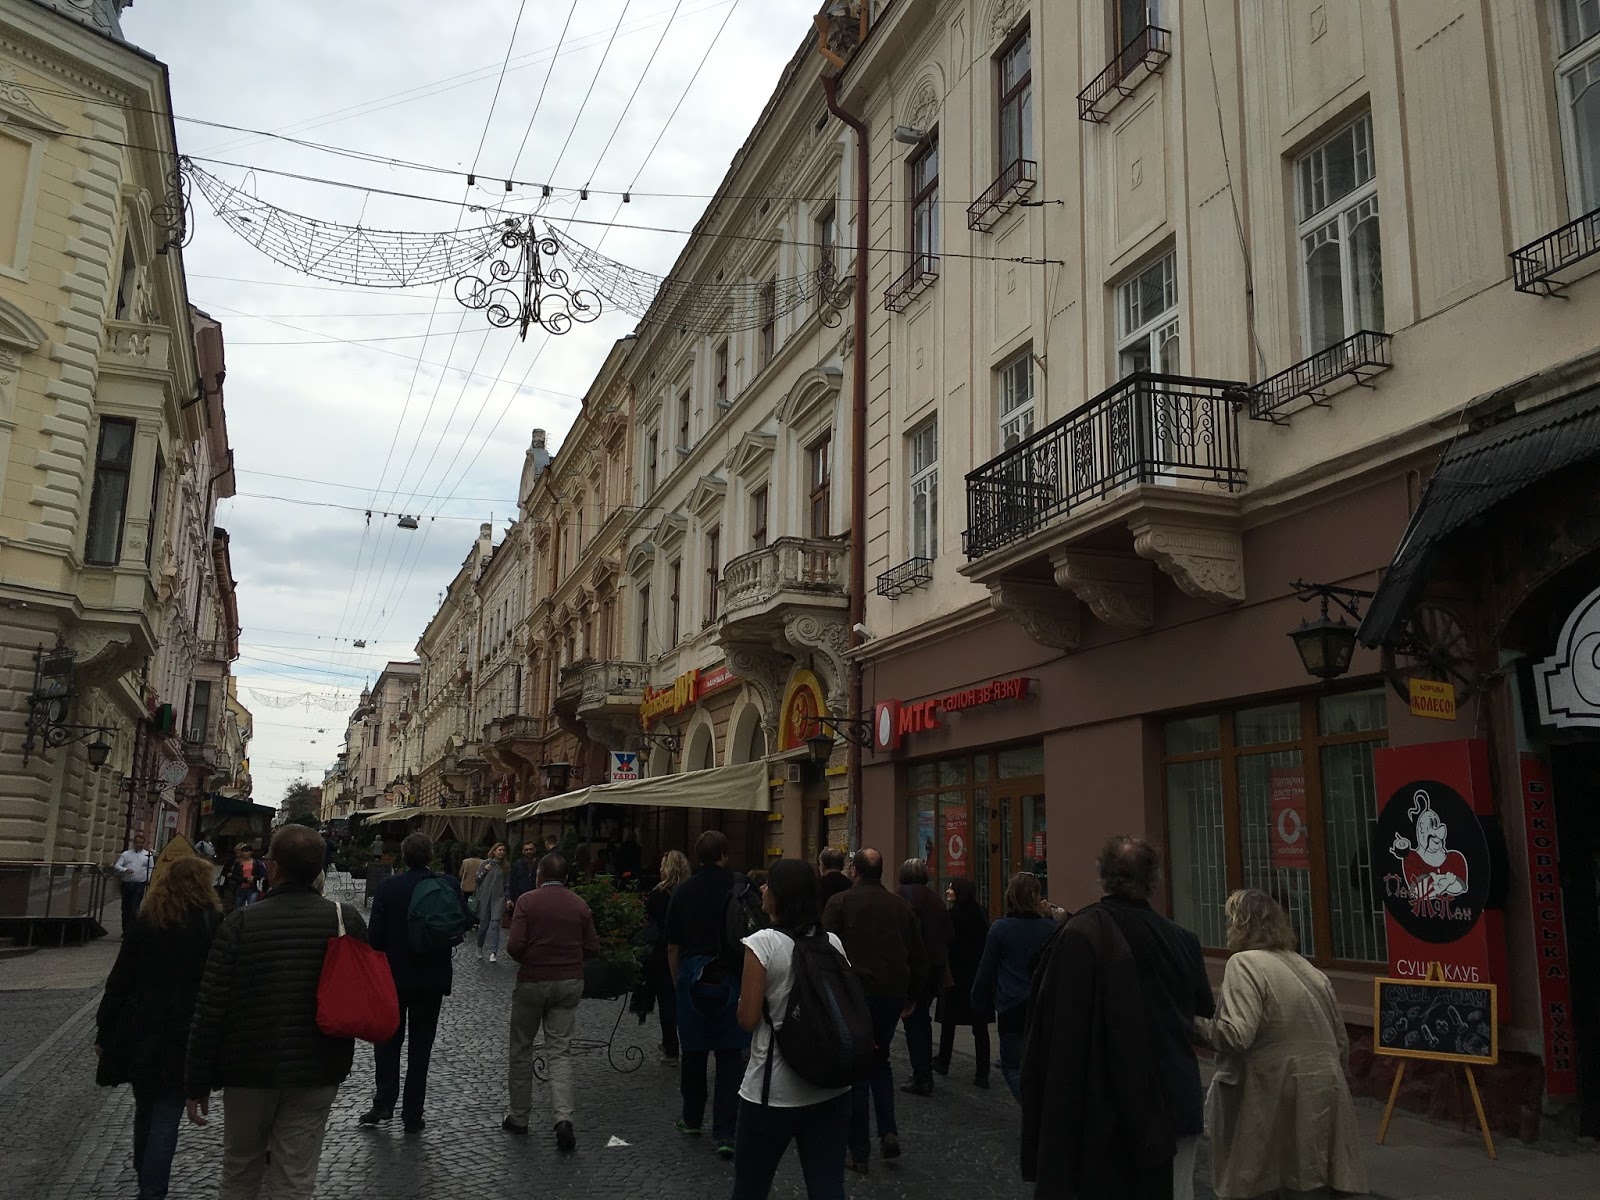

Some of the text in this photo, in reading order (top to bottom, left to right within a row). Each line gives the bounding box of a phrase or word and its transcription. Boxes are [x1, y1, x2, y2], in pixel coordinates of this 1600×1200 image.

[898, 679, 1022, 735] МТС салон зв'язку
[613, 772, 637, 780] YARD
[1529, 780, 1564, 977] БУКОВИНСЬКА
[1397, 959, 1480, 982] СУШ КЛУБ
[1549, 1001, 1569, 1072] КУХНЯ
